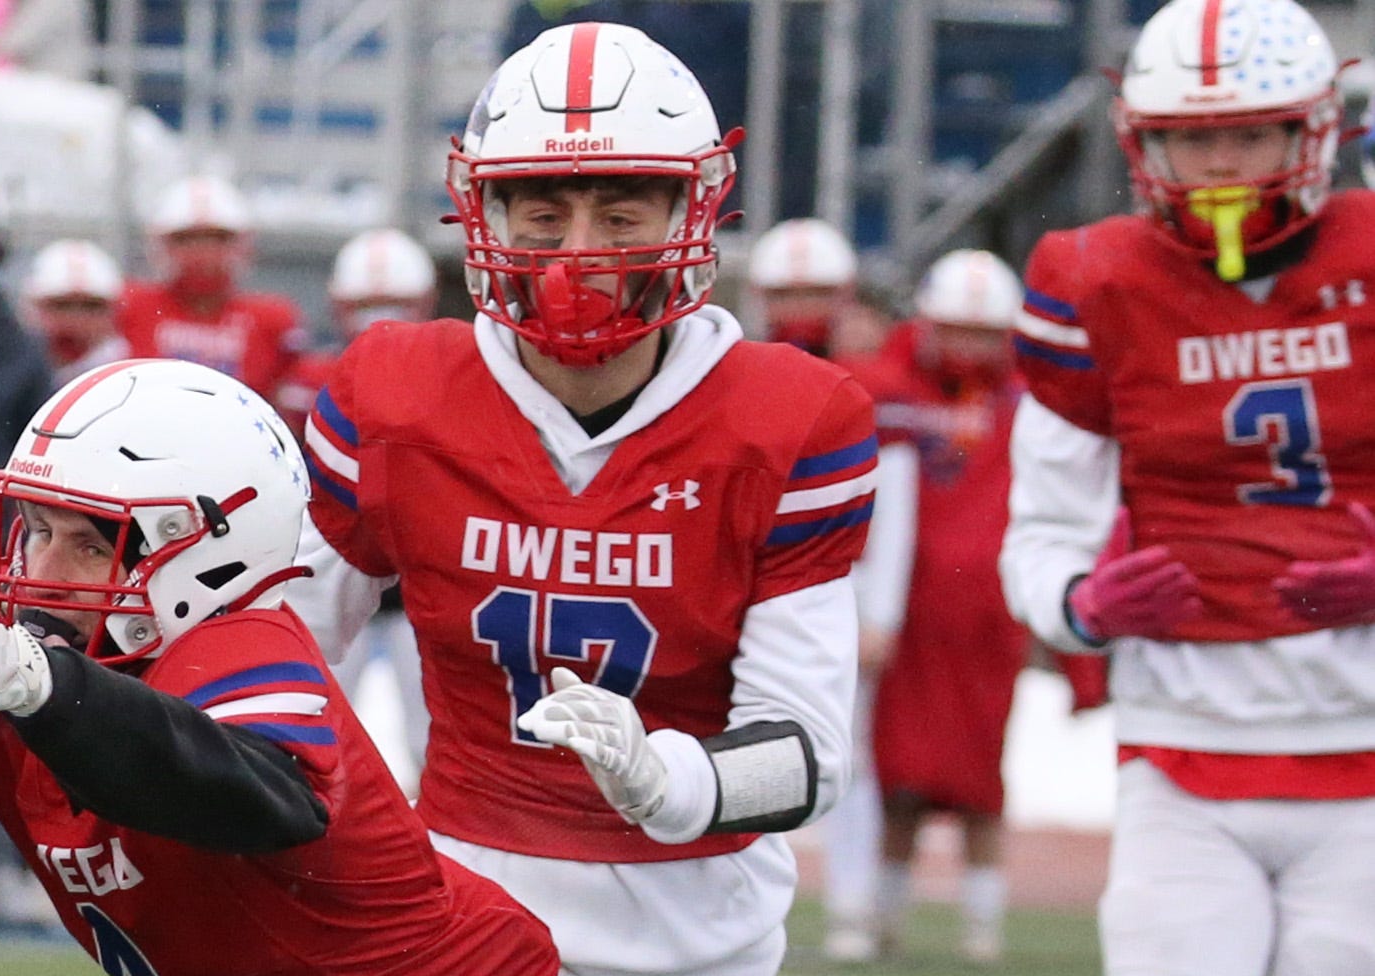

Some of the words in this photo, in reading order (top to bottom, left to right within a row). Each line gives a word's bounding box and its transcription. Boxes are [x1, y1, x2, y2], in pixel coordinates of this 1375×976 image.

[543, 136, 614, 153] Riddell
[1178, 321, 1352, 384] OWEGO
[1222, 377, 1333, 508] 3
[460, 515, 674, 588] OWEGO
[471, 585, 660, 749] 17
